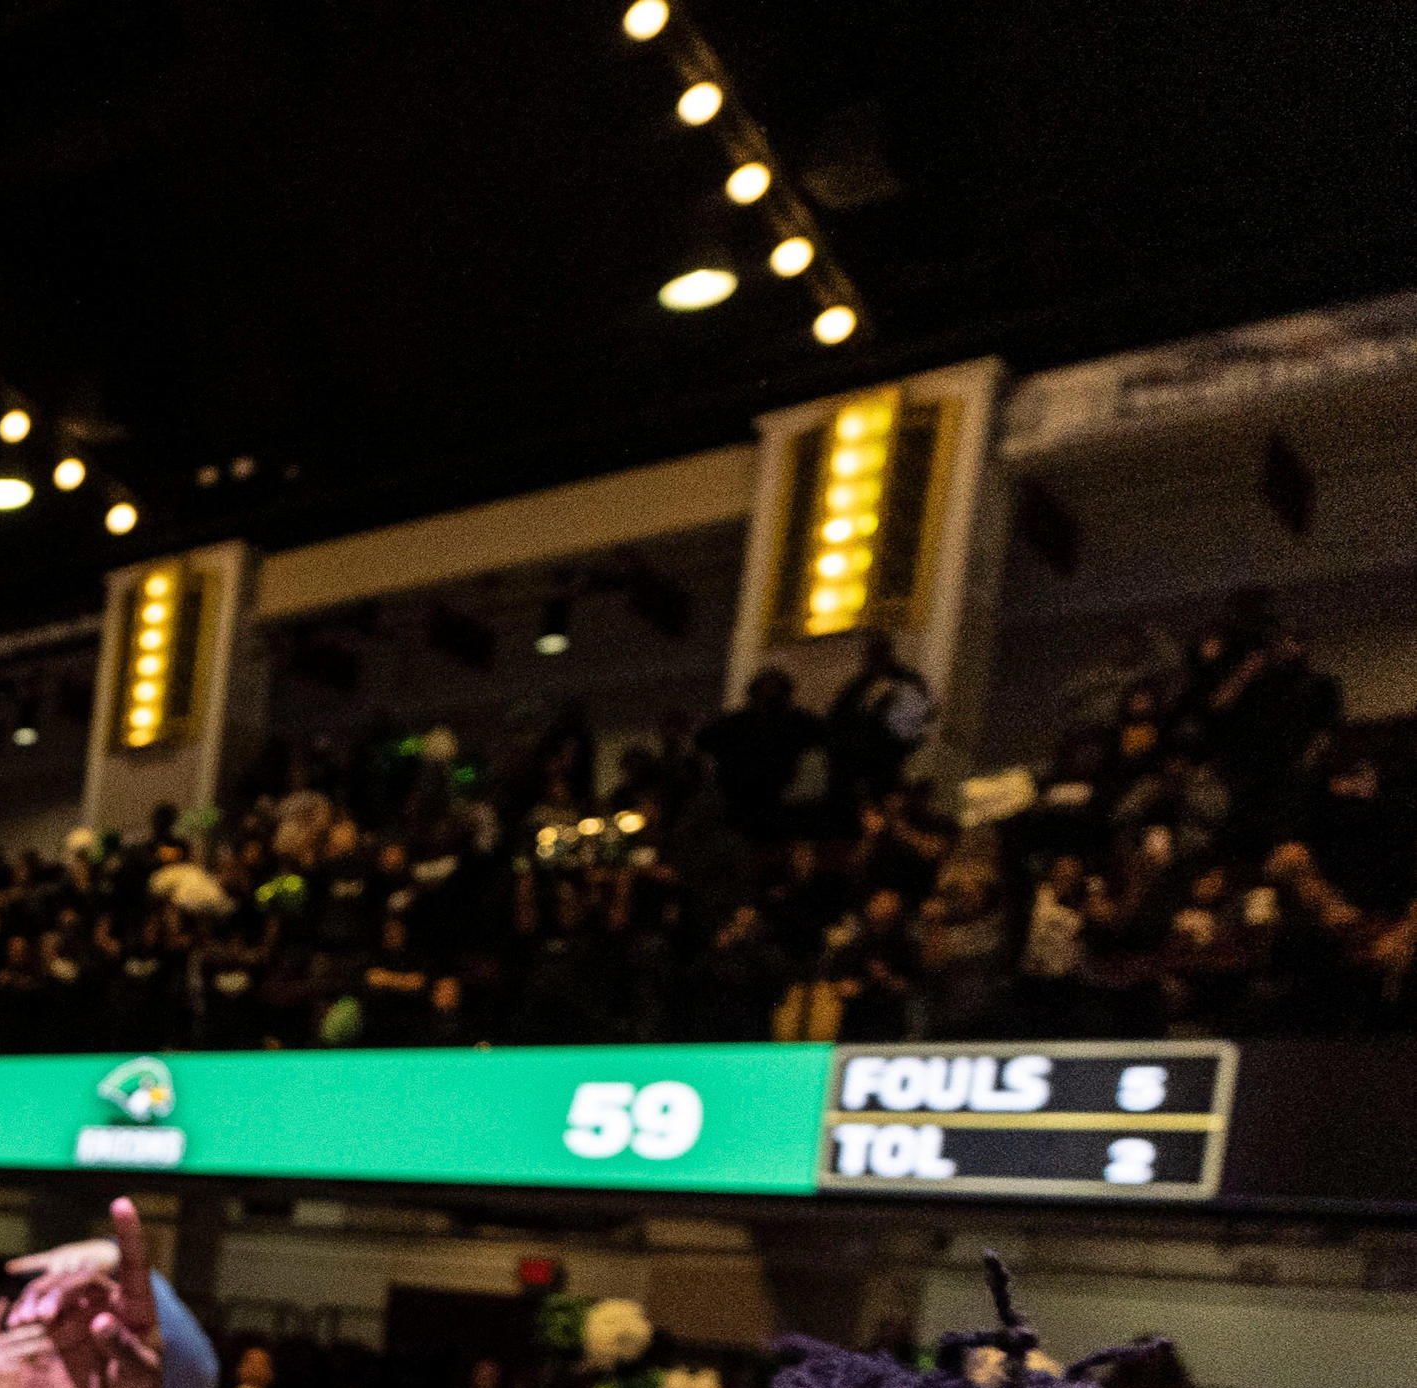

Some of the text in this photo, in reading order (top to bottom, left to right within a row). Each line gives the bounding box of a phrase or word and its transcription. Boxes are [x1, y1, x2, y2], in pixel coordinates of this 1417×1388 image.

[841, 1055, 1052, 1112] FOULS
[563, 1080, 704, 1160] 59
[833, 1123, 957, 1179] TOL
